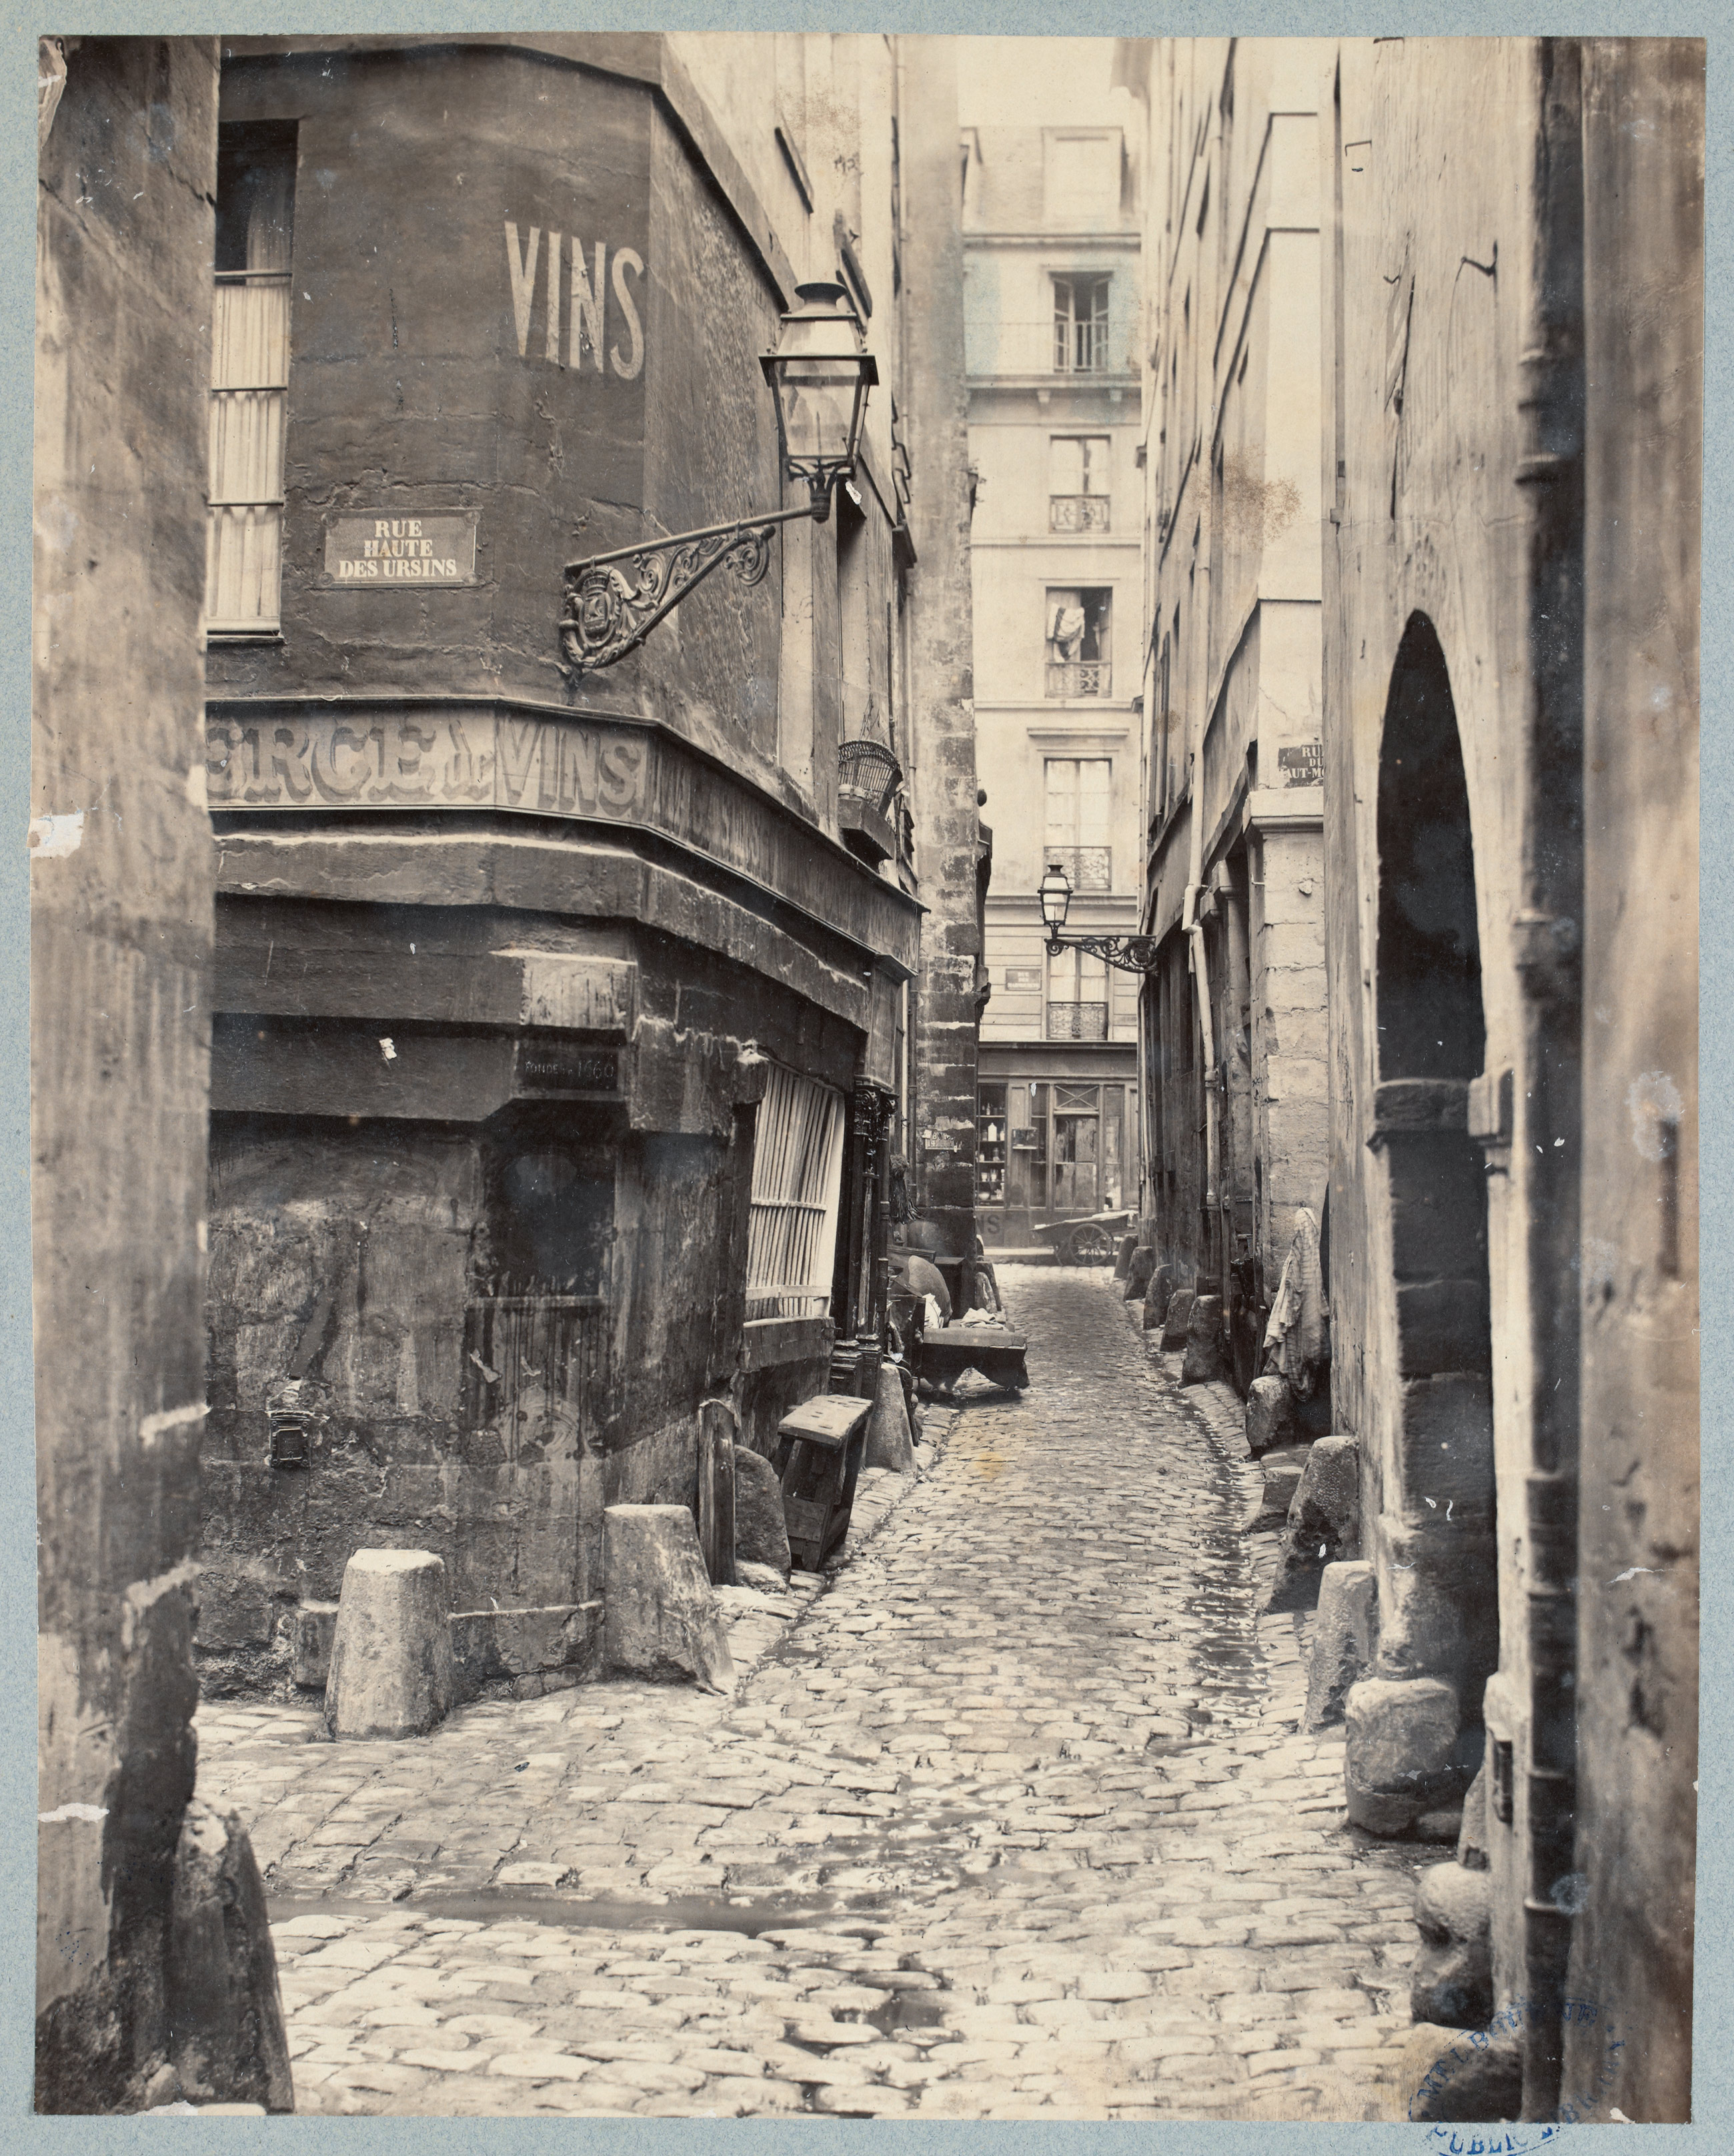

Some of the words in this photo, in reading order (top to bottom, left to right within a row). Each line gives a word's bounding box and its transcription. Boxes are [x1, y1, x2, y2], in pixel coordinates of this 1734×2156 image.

[505, 220, 645, 380] VINS
[375, 520, 422, 538] RUE
[364, 539, 433, 558] HAUTE
[339, 560, 378, 578] DES
[382, 558, 457, 578] URSINS
[1301, 746, 1324, 758] RU
[496, 715, 643, 818] VINS
